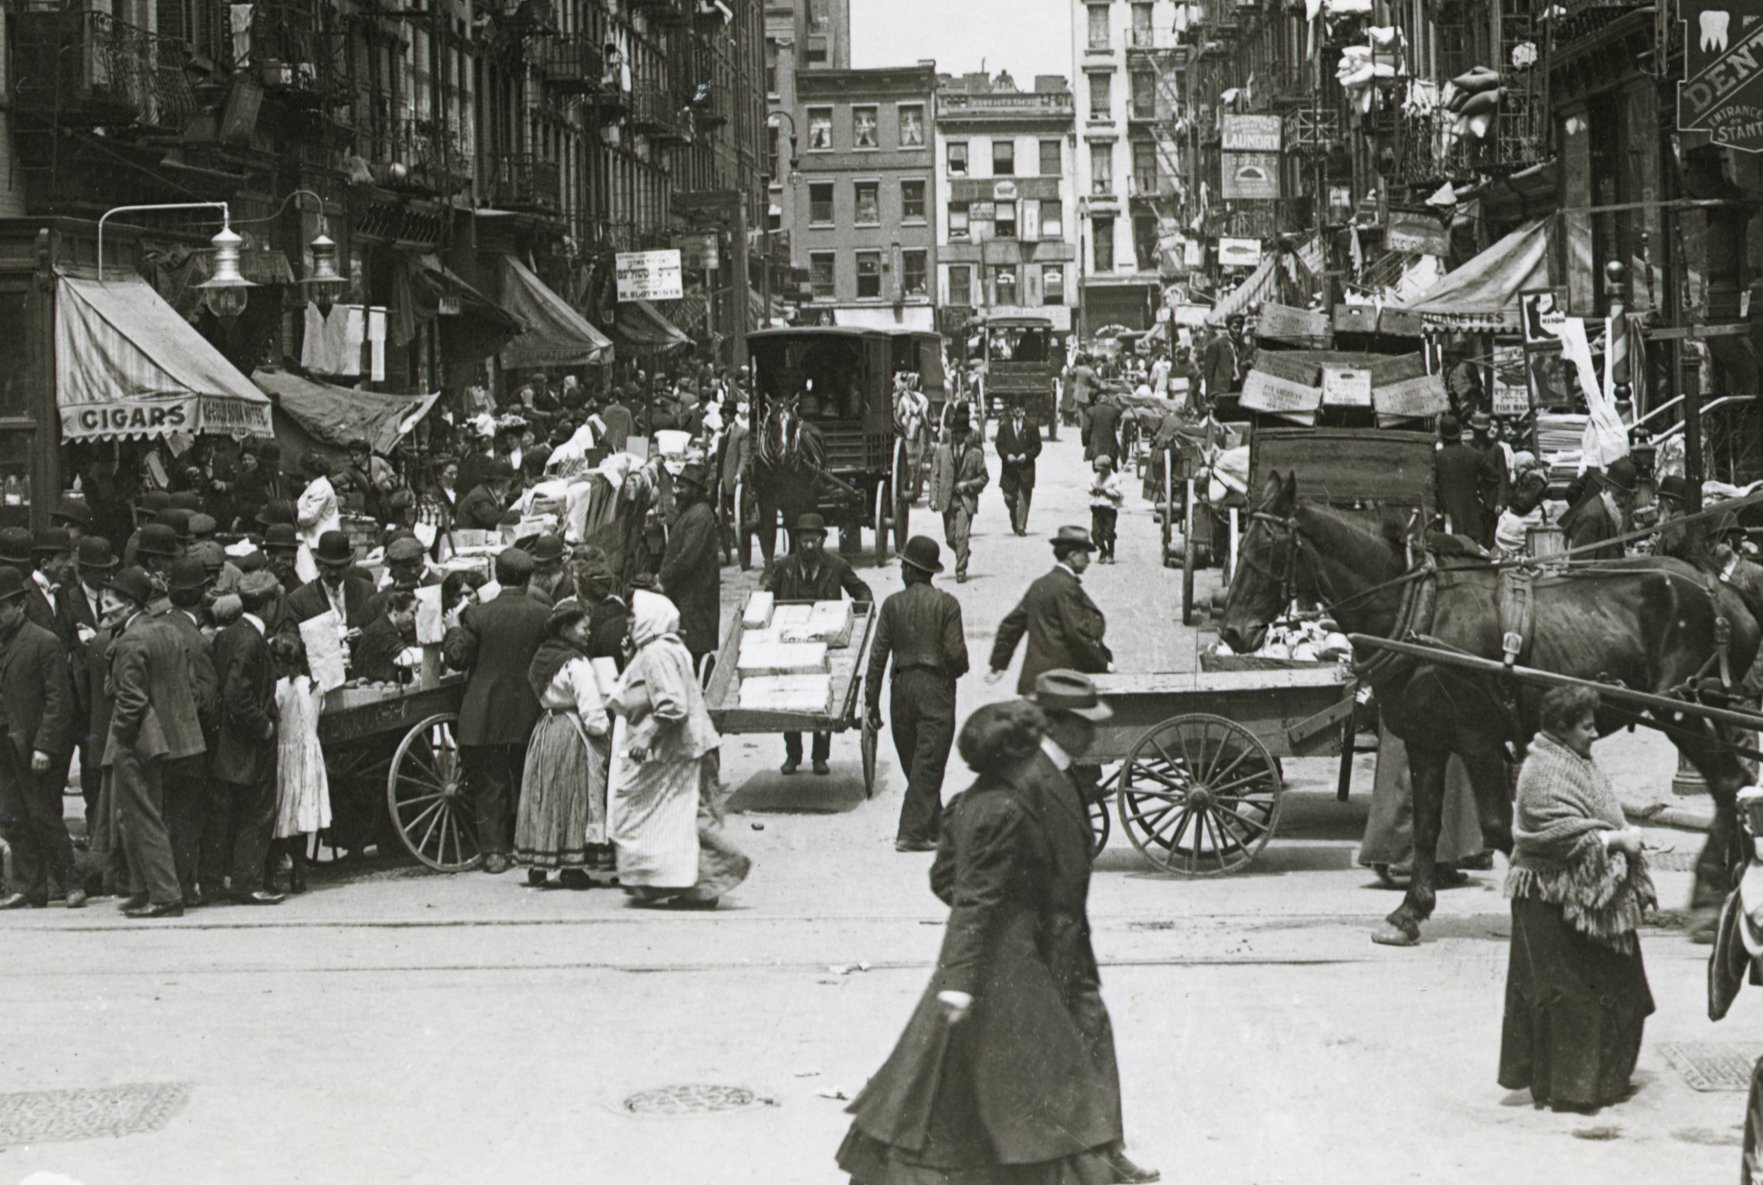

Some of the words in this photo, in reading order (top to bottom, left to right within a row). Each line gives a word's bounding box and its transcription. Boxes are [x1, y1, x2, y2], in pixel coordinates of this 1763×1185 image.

[1708, 104, 1763, 127] ENTRANCE
[1222, 132, 1280, 149] LAUNDRY
[79, 404, 186, 430] CIGARS
[1495, 403, 1511, 412] FISH
